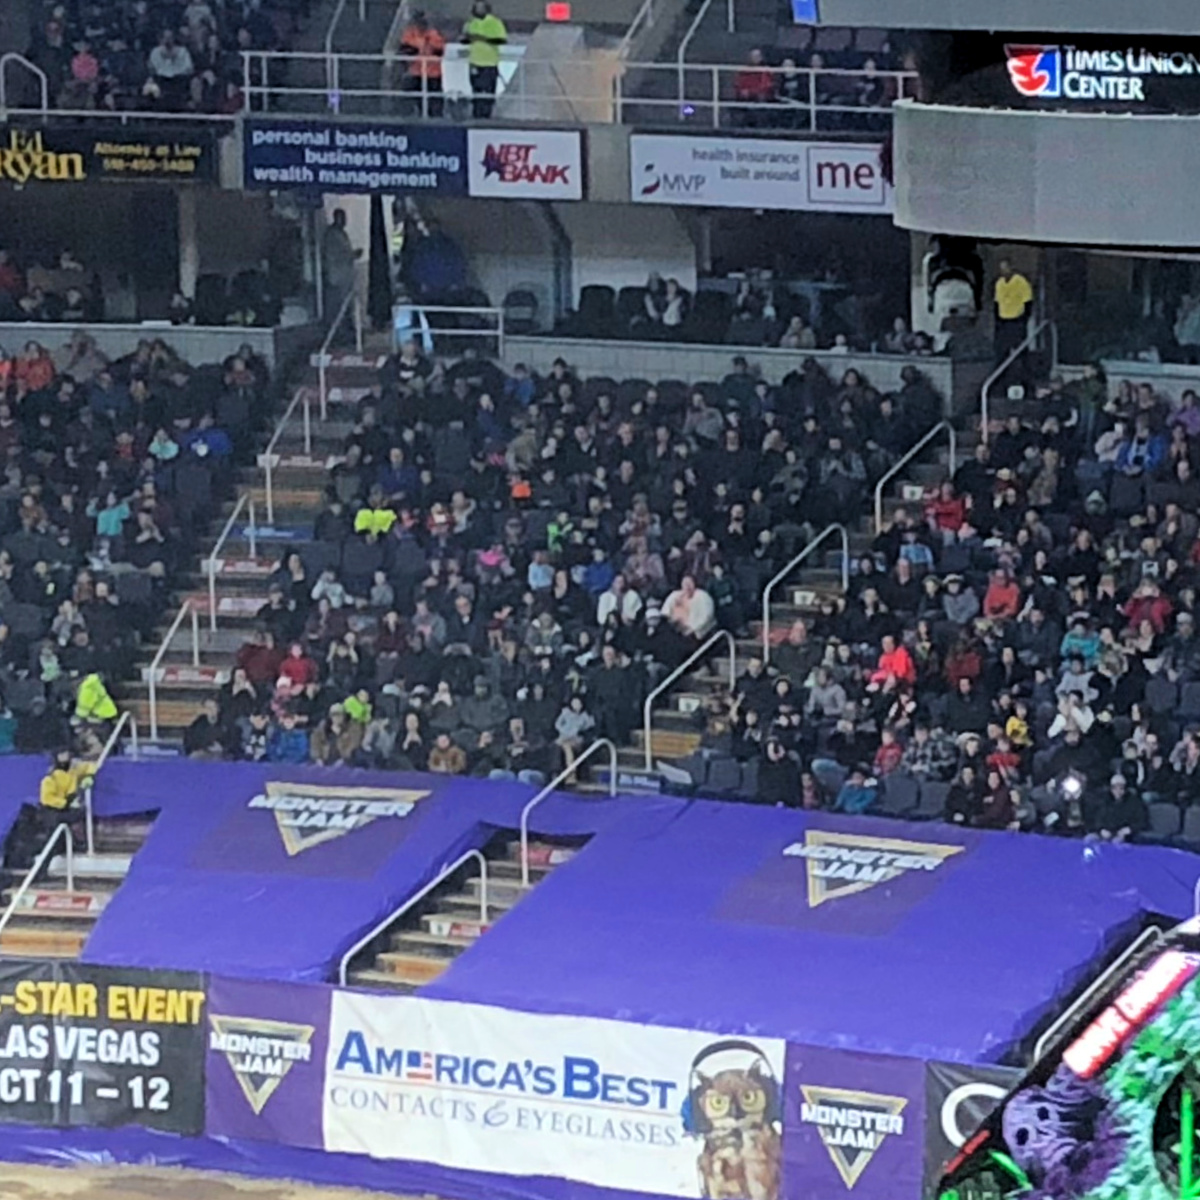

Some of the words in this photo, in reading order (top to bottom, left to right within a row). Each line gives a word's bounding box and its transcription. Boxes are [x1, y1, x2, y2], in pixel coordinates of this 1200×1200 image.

[1063, 45, 1125, 72] TIMES
[1063, 72, 1145, 101] CENTER
[252, 129, 329, 147] personal
[335, 130, 408, 151] banking
[0, 148, 87, 183] Ryan
[304, 148, 382, 167] business
[386, 151, 460, 172] banking
[692, 148, 733, 160] health
[736, 149, 799, 164] insurance
[253, 166, 314, 183] wealth
[318, 169, 438, 188] management
[498, 164, 570, 184] BANK
[662, 173, 706, 192] MVP
[720, 166, 750, 179] built
[753, 169, 800, 182] around
[816, 160, 875, 190] me
[248, 794, 415, 817] MONSTER
[281, 811, 360, 829] JAM
[782, 843, 944, 870] MONSTER
[811, 861, 888, 882] JAM
[0, 980, 98, 1017] -STAR
[107, 985, 206, 1025] EVENT
[54, 1025, 161, 1067] VEGAS
[209, 1031, 311, 1062] MONSTER
[235, 1054, 282, 1076] JAM
[47, 1069, 84, 1105] 11
[127, 1075, 171, 1111] 12
[330, 1086, 477, 1122] CONTACTS
[516, 1106, 677, 1147] EYEGLASSES
[800, 1102, 904, 1135] MONSTER
[825, 1125, 875, 1150] JAM
